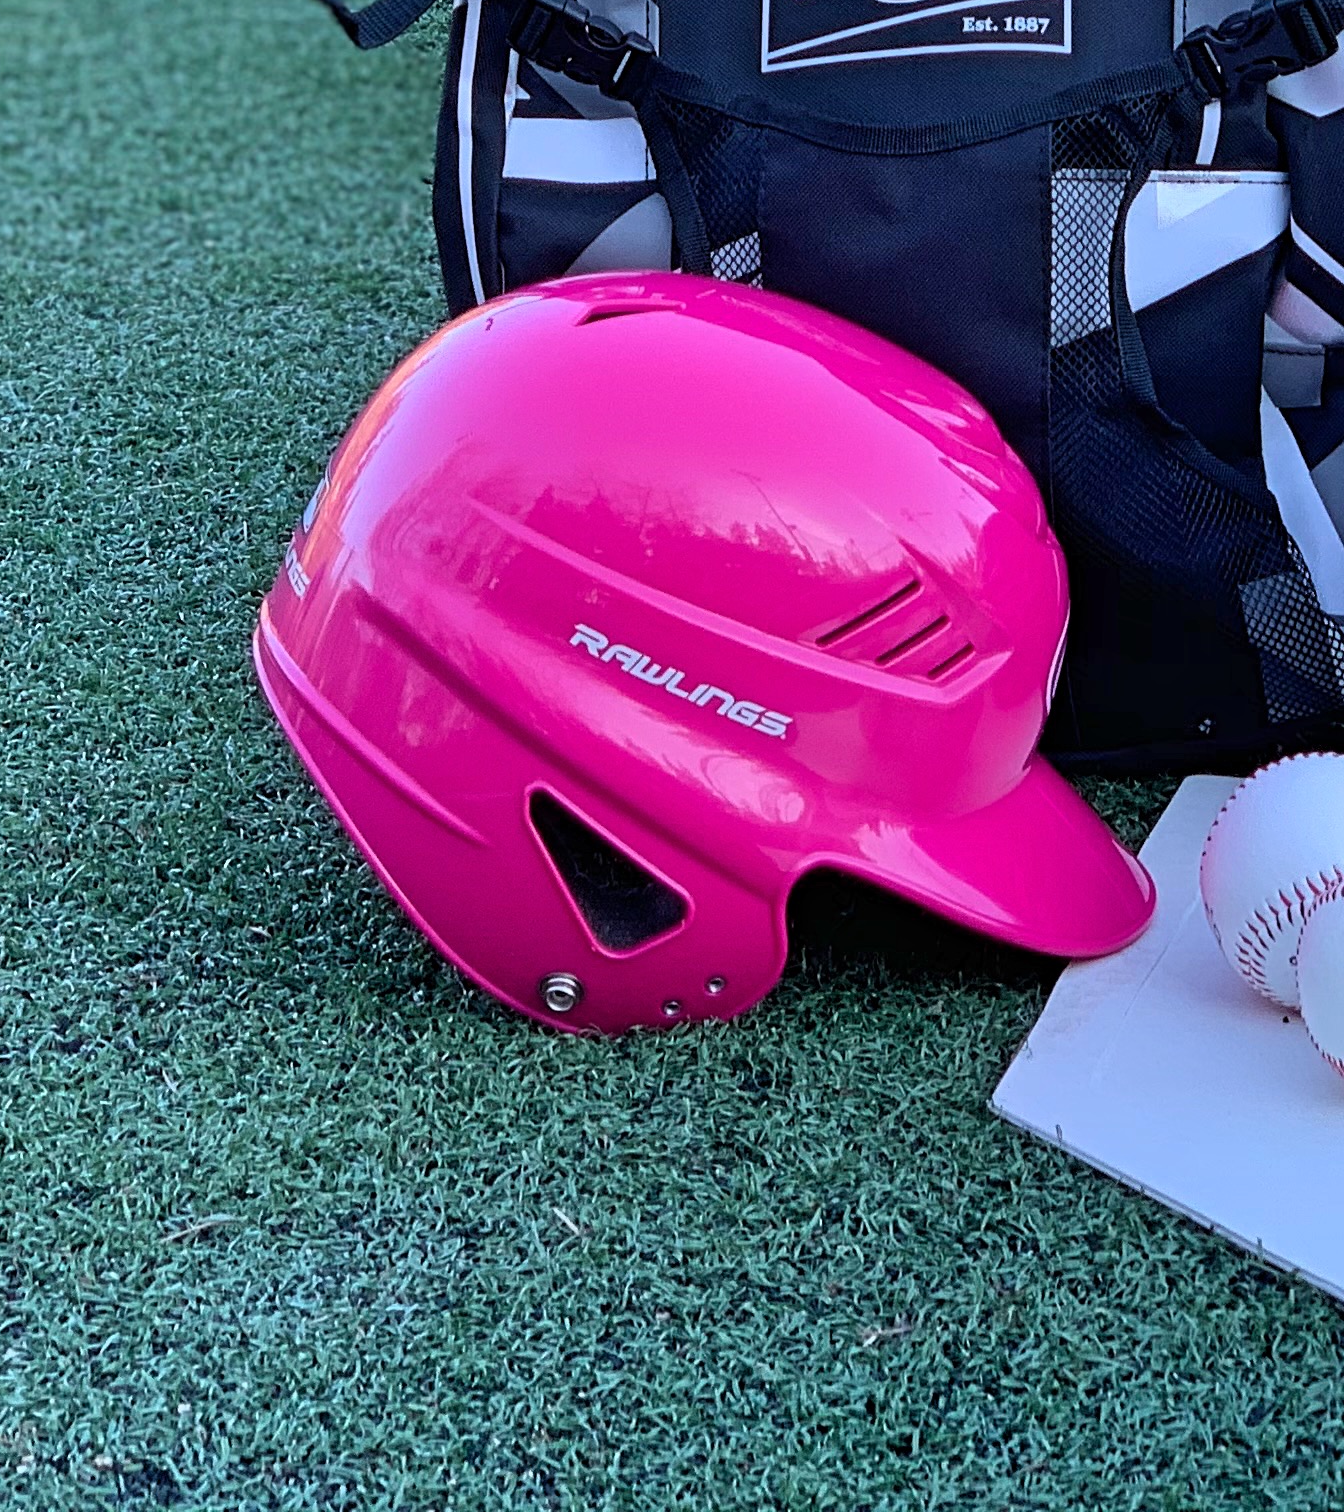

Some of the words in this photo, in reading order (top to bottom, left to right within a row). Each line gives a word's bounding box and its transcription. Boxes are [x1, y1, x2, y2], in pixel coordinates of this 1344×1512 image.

[962, 17, 998, 33] Est.
[1004, 16, 1050, 34] 1887
[569, 623, 794, 740] RAWLINGS
